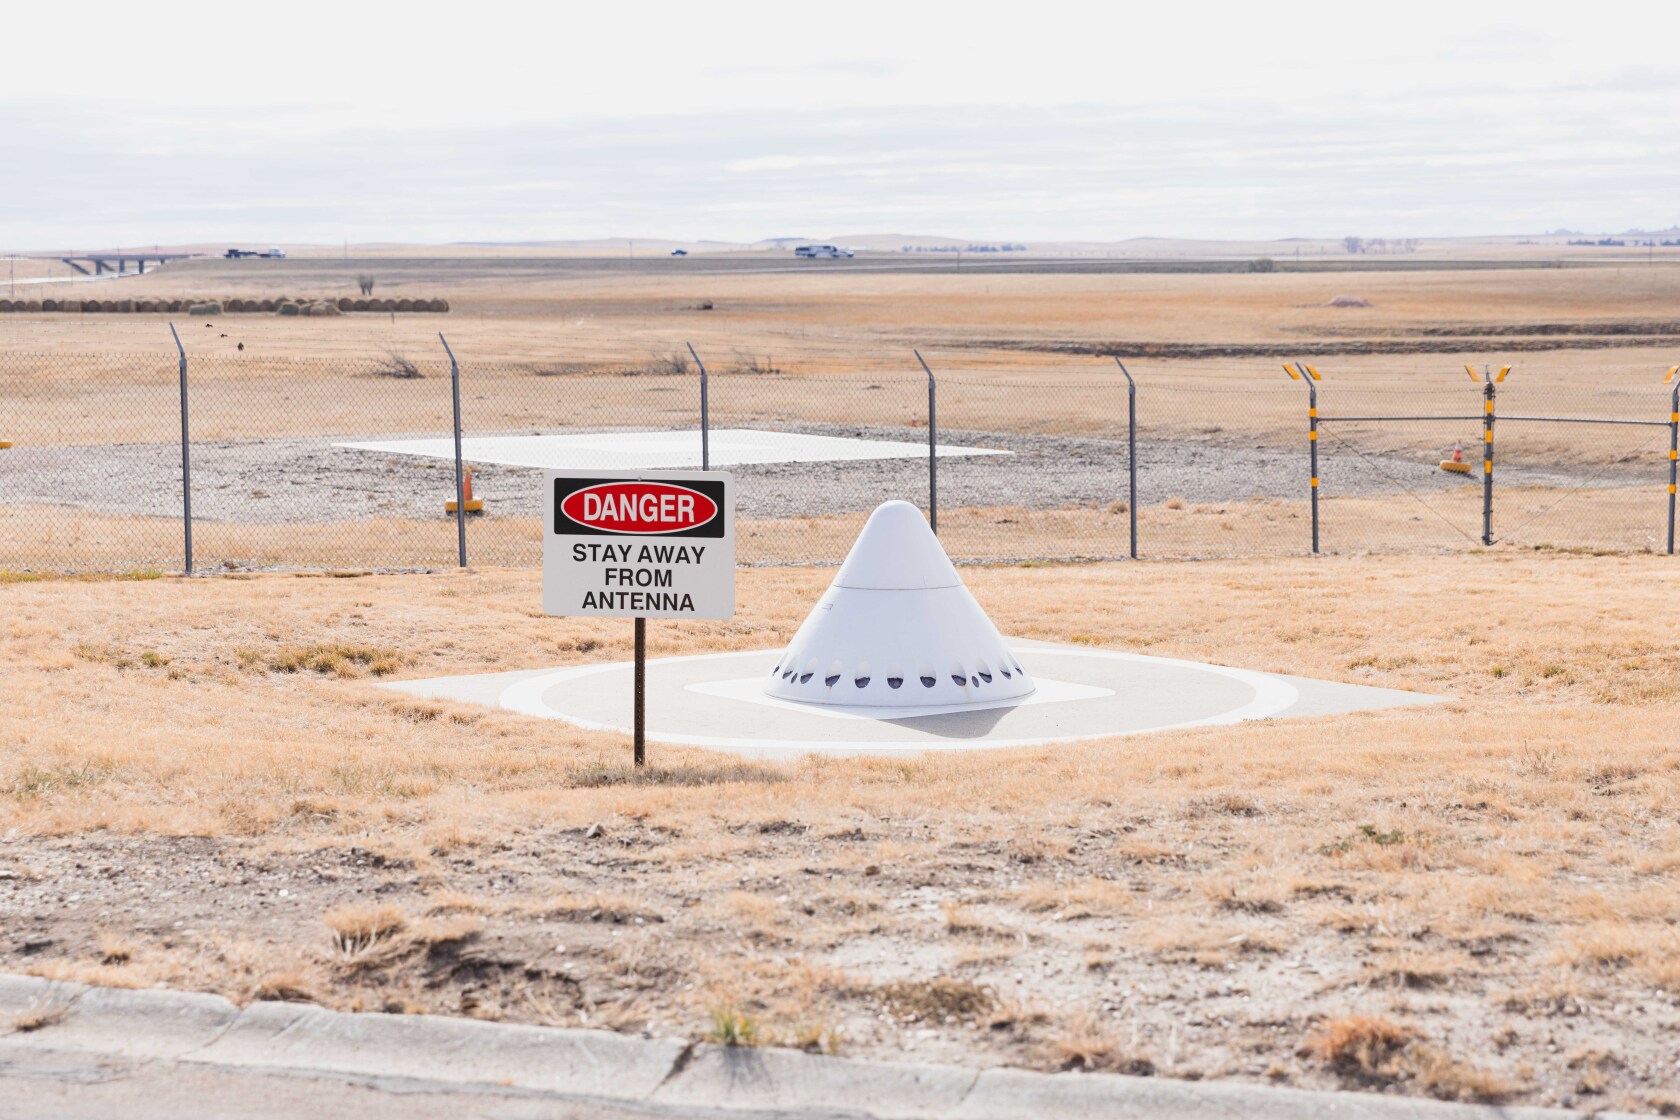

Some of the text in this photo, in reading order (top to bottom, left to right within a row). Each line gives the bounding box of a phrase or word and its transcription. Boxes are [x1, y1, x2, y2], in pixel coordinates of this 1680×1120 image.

[583, 493, 695, 523] DANGER
[572, 543, 706, 564] STAY AWAY
[605, 568, 672, 587] FROM
[582, 591, 695, 611] ANTENNA
